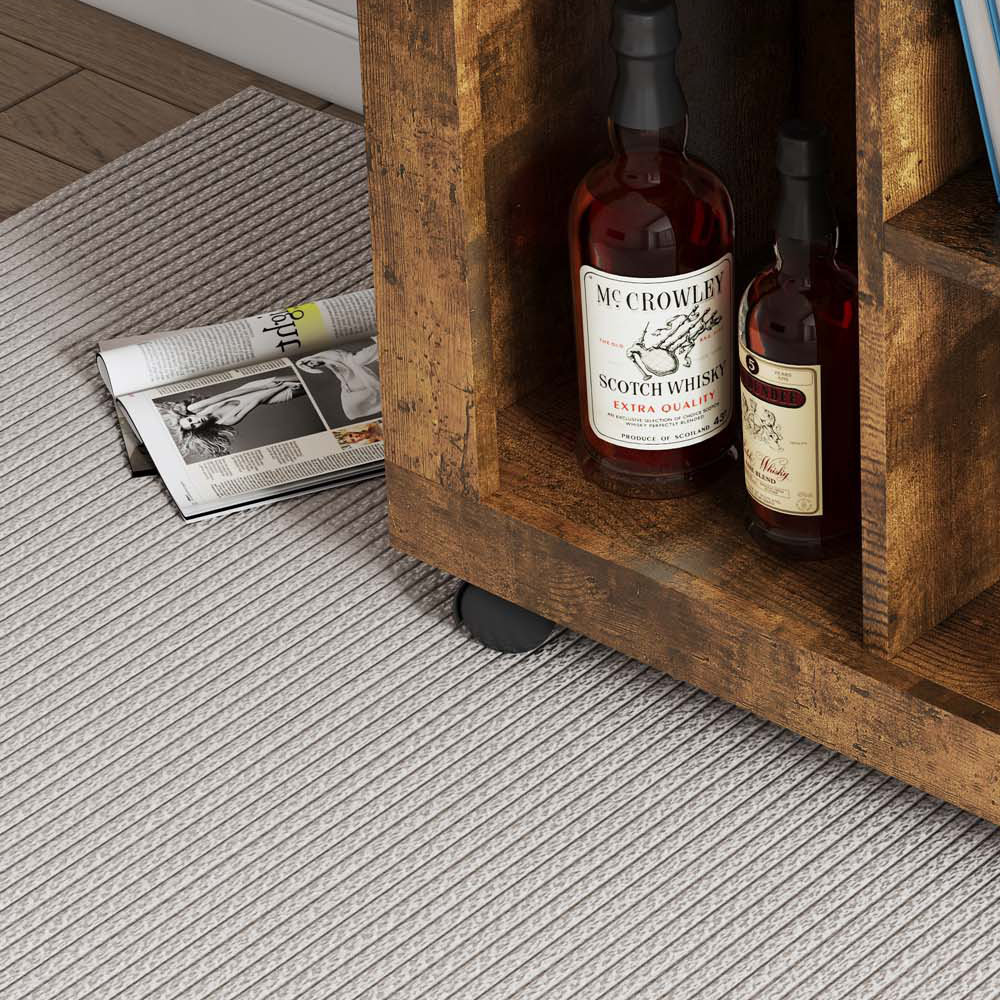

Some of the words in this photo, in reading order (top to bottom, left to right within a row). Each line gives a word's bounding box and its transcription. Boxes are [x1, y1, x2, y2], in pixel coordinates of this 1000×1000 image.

[626, 271, 724, 311] CROWLEY
[748, 358, 756, 371] 5
[599, 374, 662, 397] SCOTCH
[667, 359, 727, 395] WHISKY
[613, 400, 655, 413] EXTRA
[661, 391, 716, 413] QUALITY
[621, 433, 656, 441] PRODUCE
[674, 424, 711, 439] SCOTLAND
